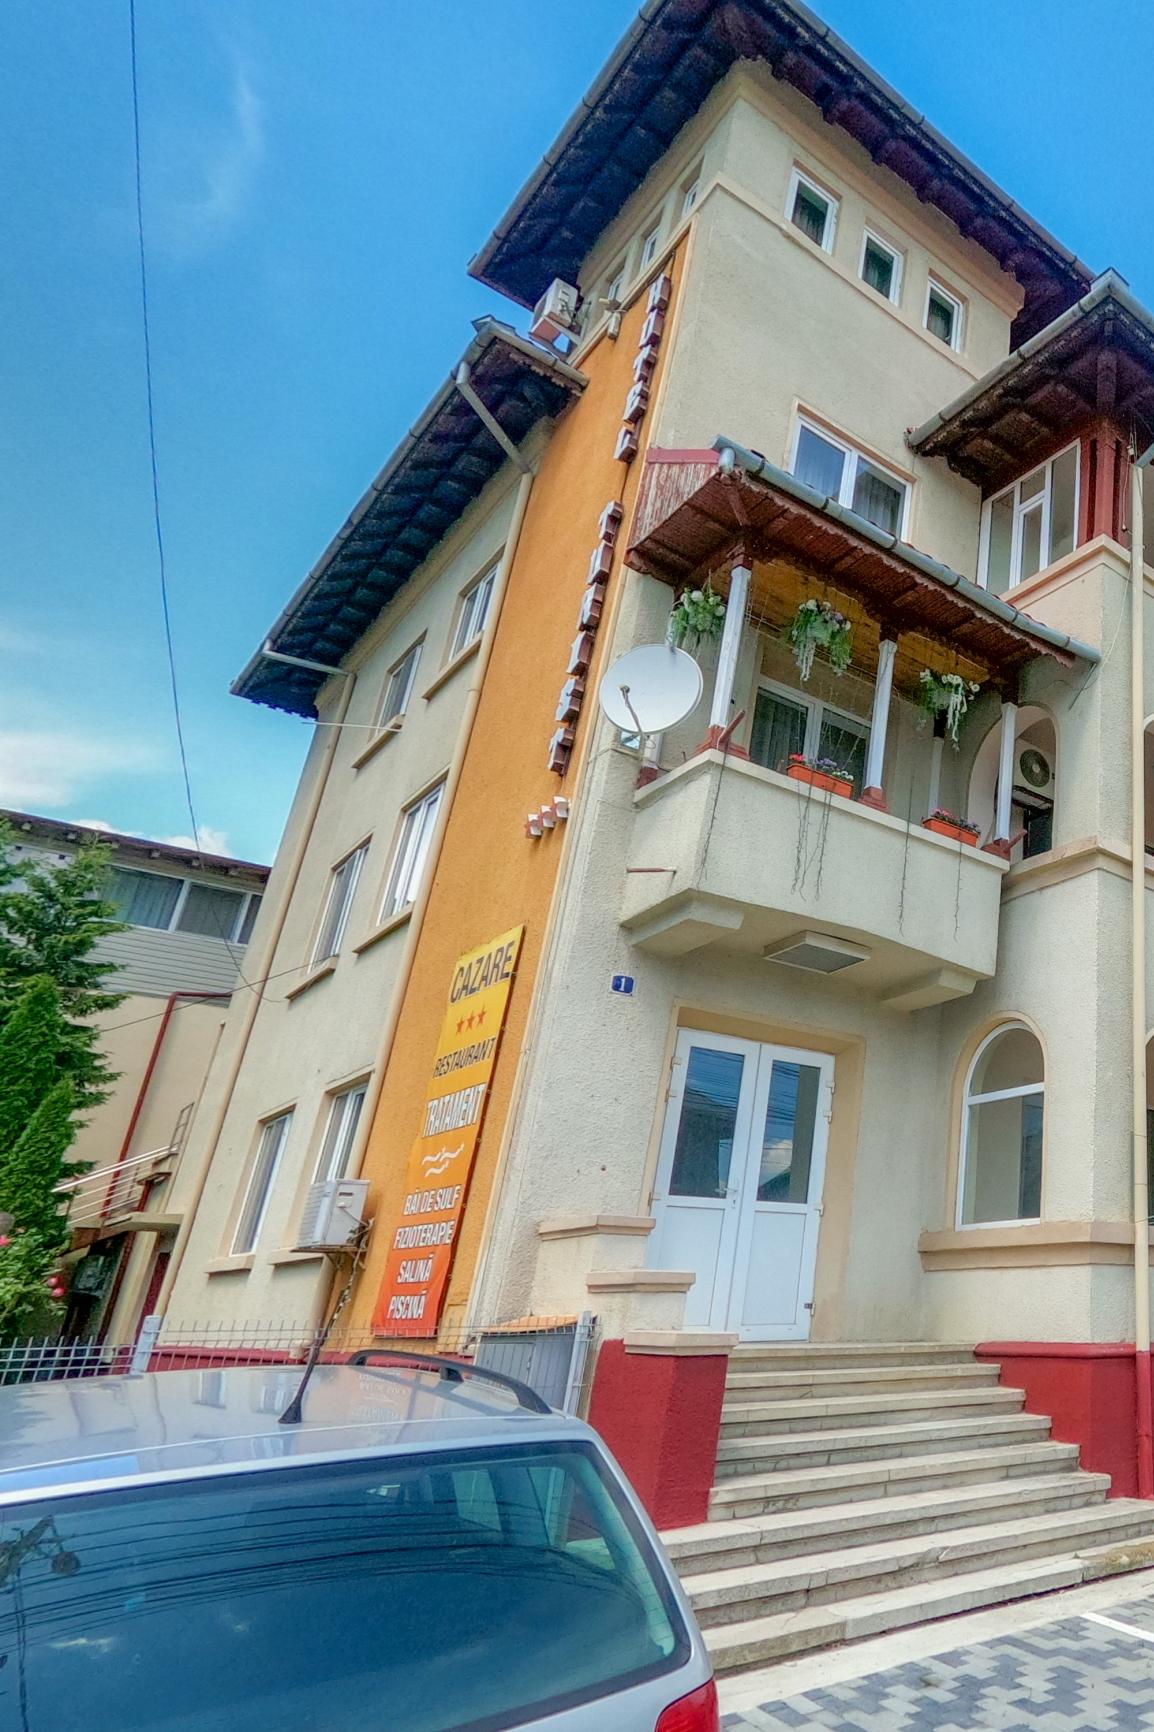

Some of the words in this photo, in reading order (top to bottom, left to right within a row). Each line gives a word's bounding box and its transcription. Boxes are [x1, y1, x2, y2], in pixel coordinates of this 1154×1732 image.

[450, 941, 515, 1003] CAZARE
[618, 977, 626, 992] 1
[432, 1037, 497, 1079] RESTAURANT
[422, 1082, 486, 1137] TRATAMENT
[419, 1190, 436, 1214] DE
[434, 1184, 461, 1212] SULF
[393, 1221, 455, 1249] FIZIOTERAPIE
